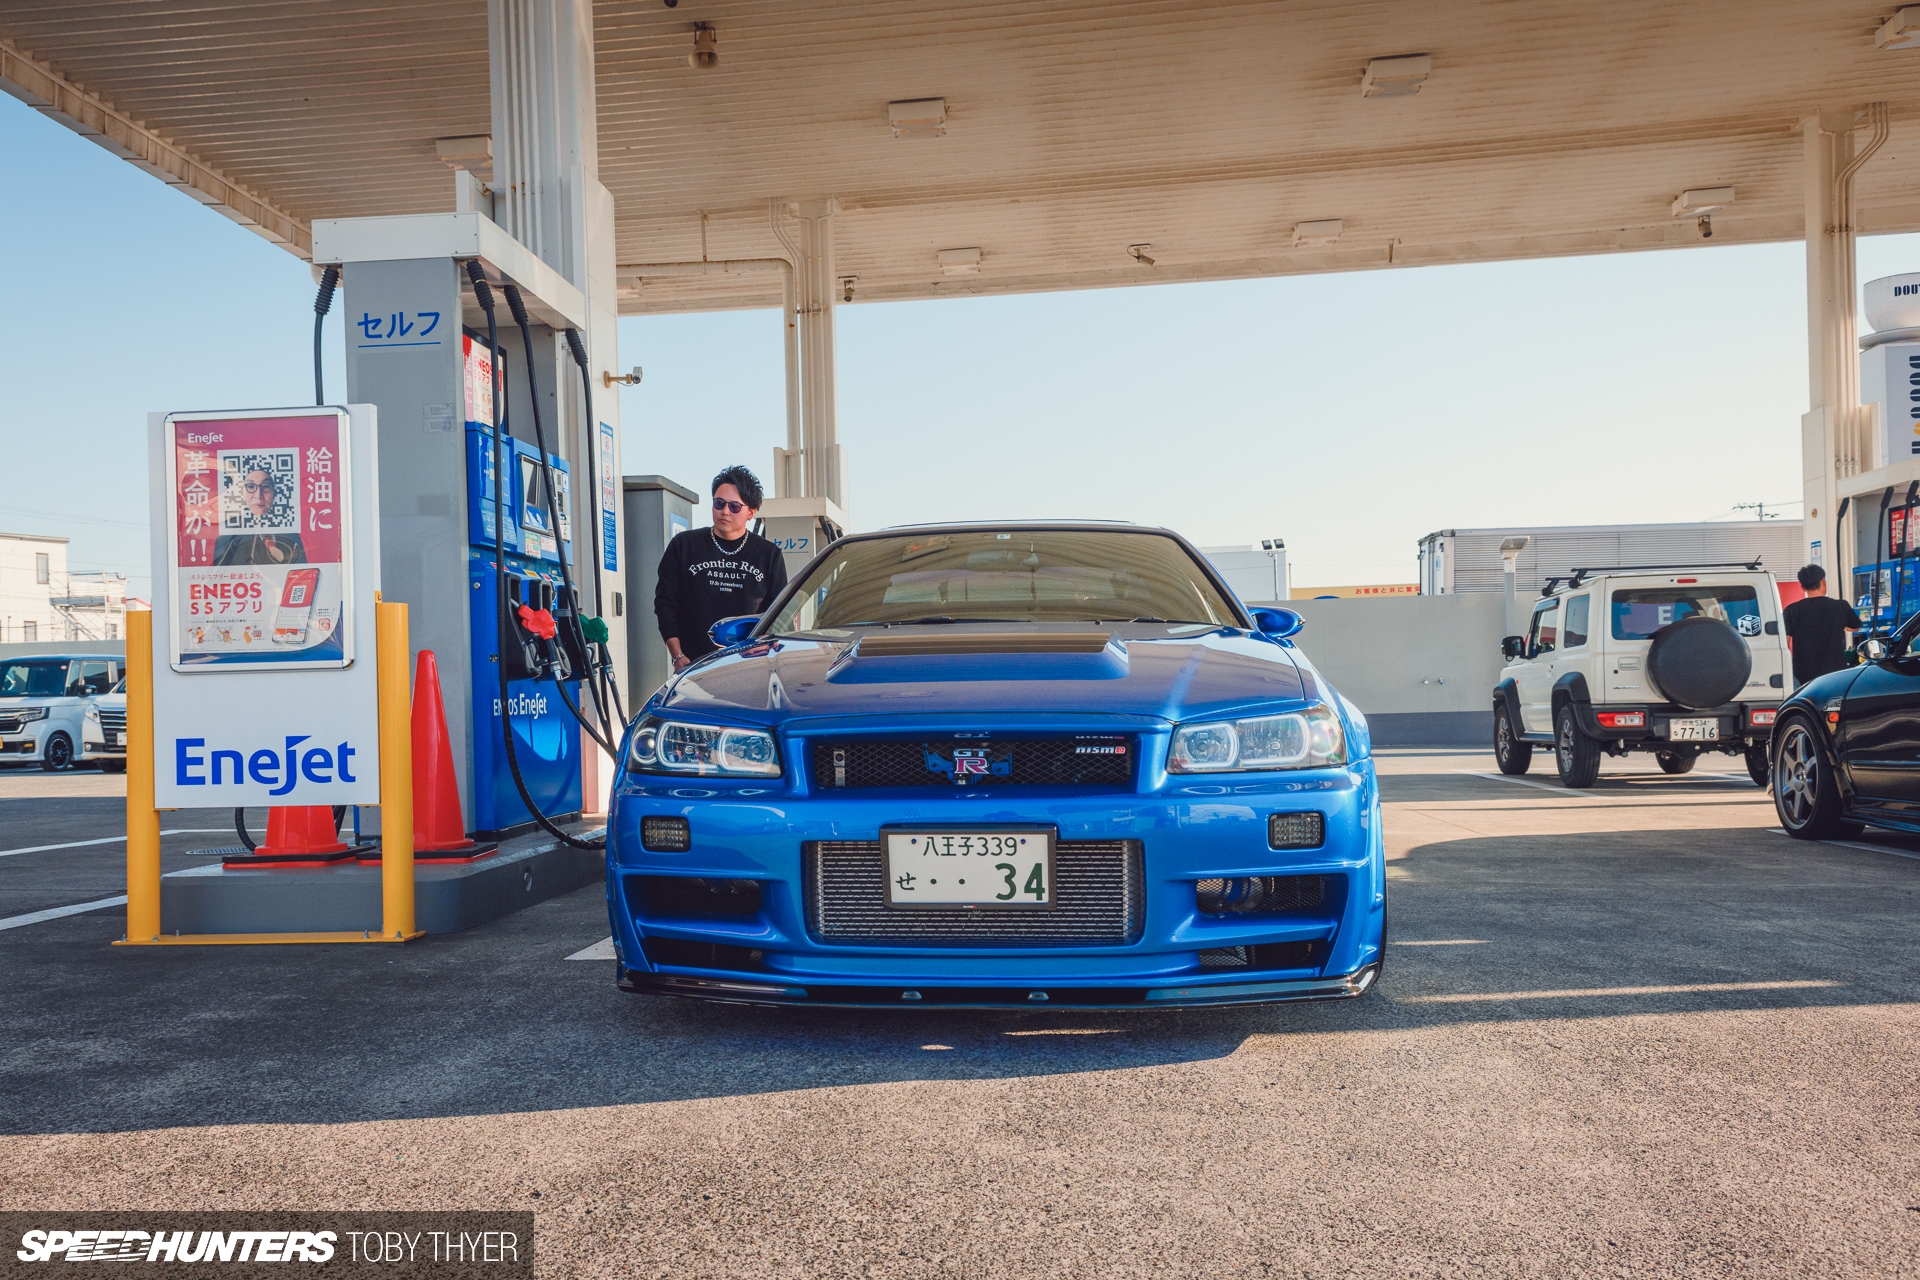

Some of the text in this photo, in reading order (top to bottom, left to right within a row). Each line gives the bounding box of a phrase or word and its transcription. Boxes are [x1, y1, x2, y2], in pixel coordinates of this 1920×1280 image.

[1894, 284, 1920, 296] DOU
[357, 311, 440, 338] セルフ
[306, 446, 333, 531] 給油に
[688, 559, 738, 576] Frontier
[707, 570, 747, 579] ASSAULT
[190, 582, 262, 600] ENEOS
[1681, 727, 1715, 738] 77-16
[953, 748, 990, 757] GT
[954, 757, 989, 774] R
[895, 872, 916, 890] せ
[994, 862, 1046, 901] 34
